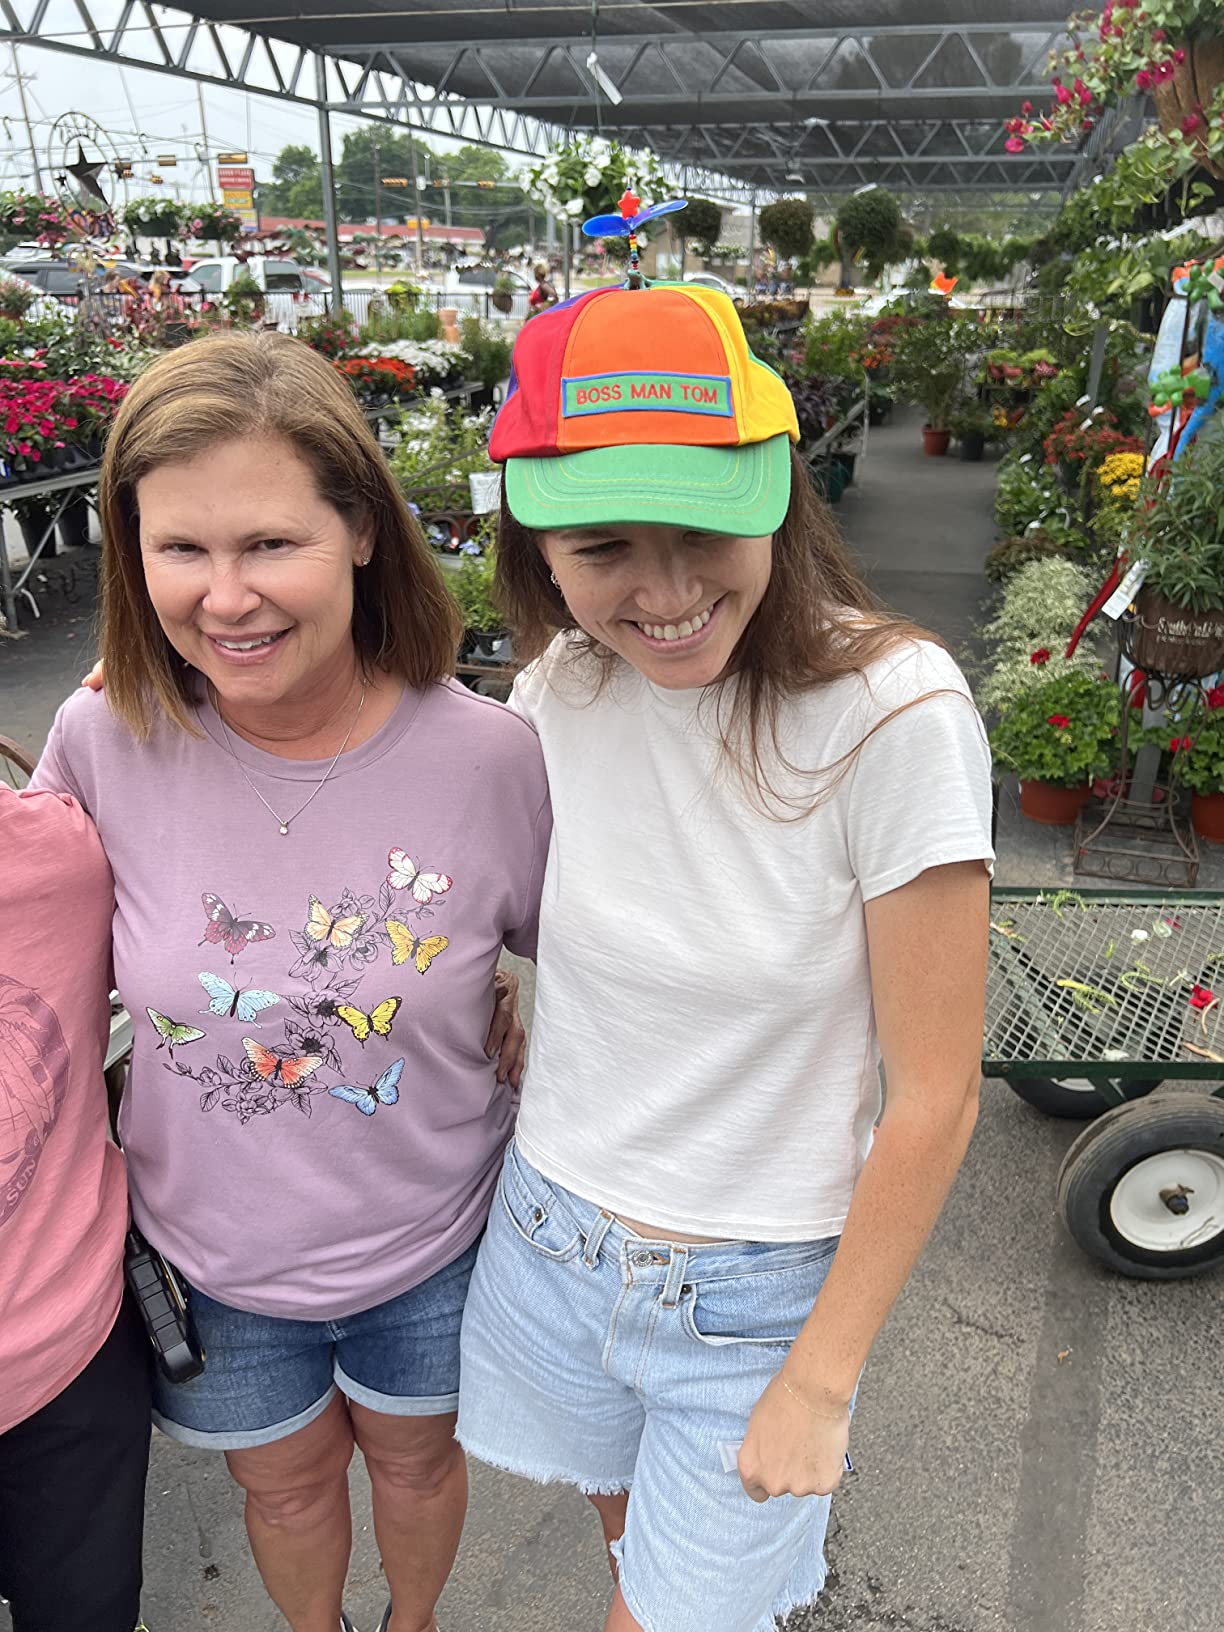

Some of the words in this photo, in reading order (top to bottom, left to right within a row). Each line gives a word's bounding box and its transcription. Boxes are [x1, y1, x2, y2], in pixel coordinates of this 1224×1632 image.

[576, 384, 622, 405] BOSS
[631, 383, 672, 400] MAN
[679, 384, 718, 405] TOM
